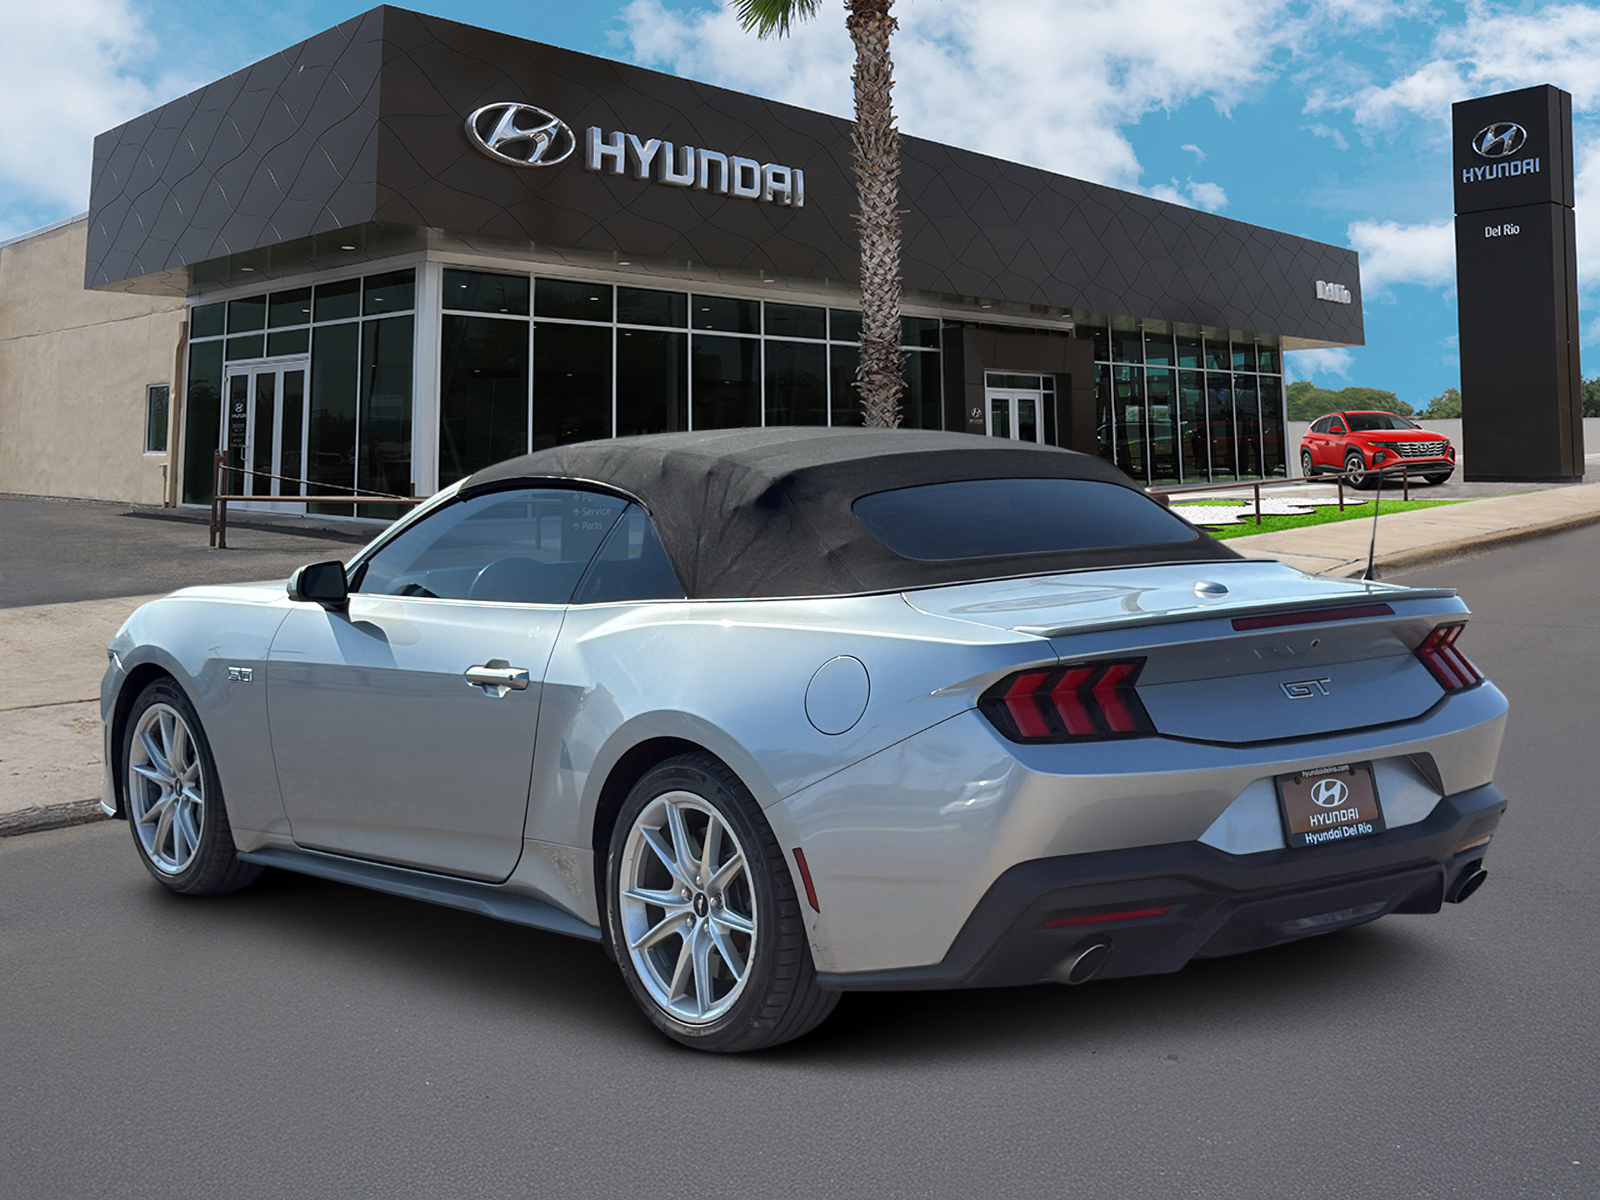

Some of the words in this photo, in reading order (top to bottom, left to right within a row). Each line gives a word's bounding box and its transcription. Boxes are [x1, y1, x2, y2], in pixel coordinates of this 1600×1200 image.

[585, 126, 804, 207] HYUNDAI
[1462, 157, 1540, 183] HYUNDAI
[1485, 225, 1501, 238] Del
[1503, 223, 1520, 236] Rio
[582, 506, 611, 517] Service
[582, 521, 602, 531] Parts
[1279, 677, 1331, 700] GT
[1309, 808, 1359, 827] HYUNDAI
[1305, 826, 1343, 845] Hyundai
[1343, 823, 1358, 837] Del
[1359, 821, 1373, 834] Rio
